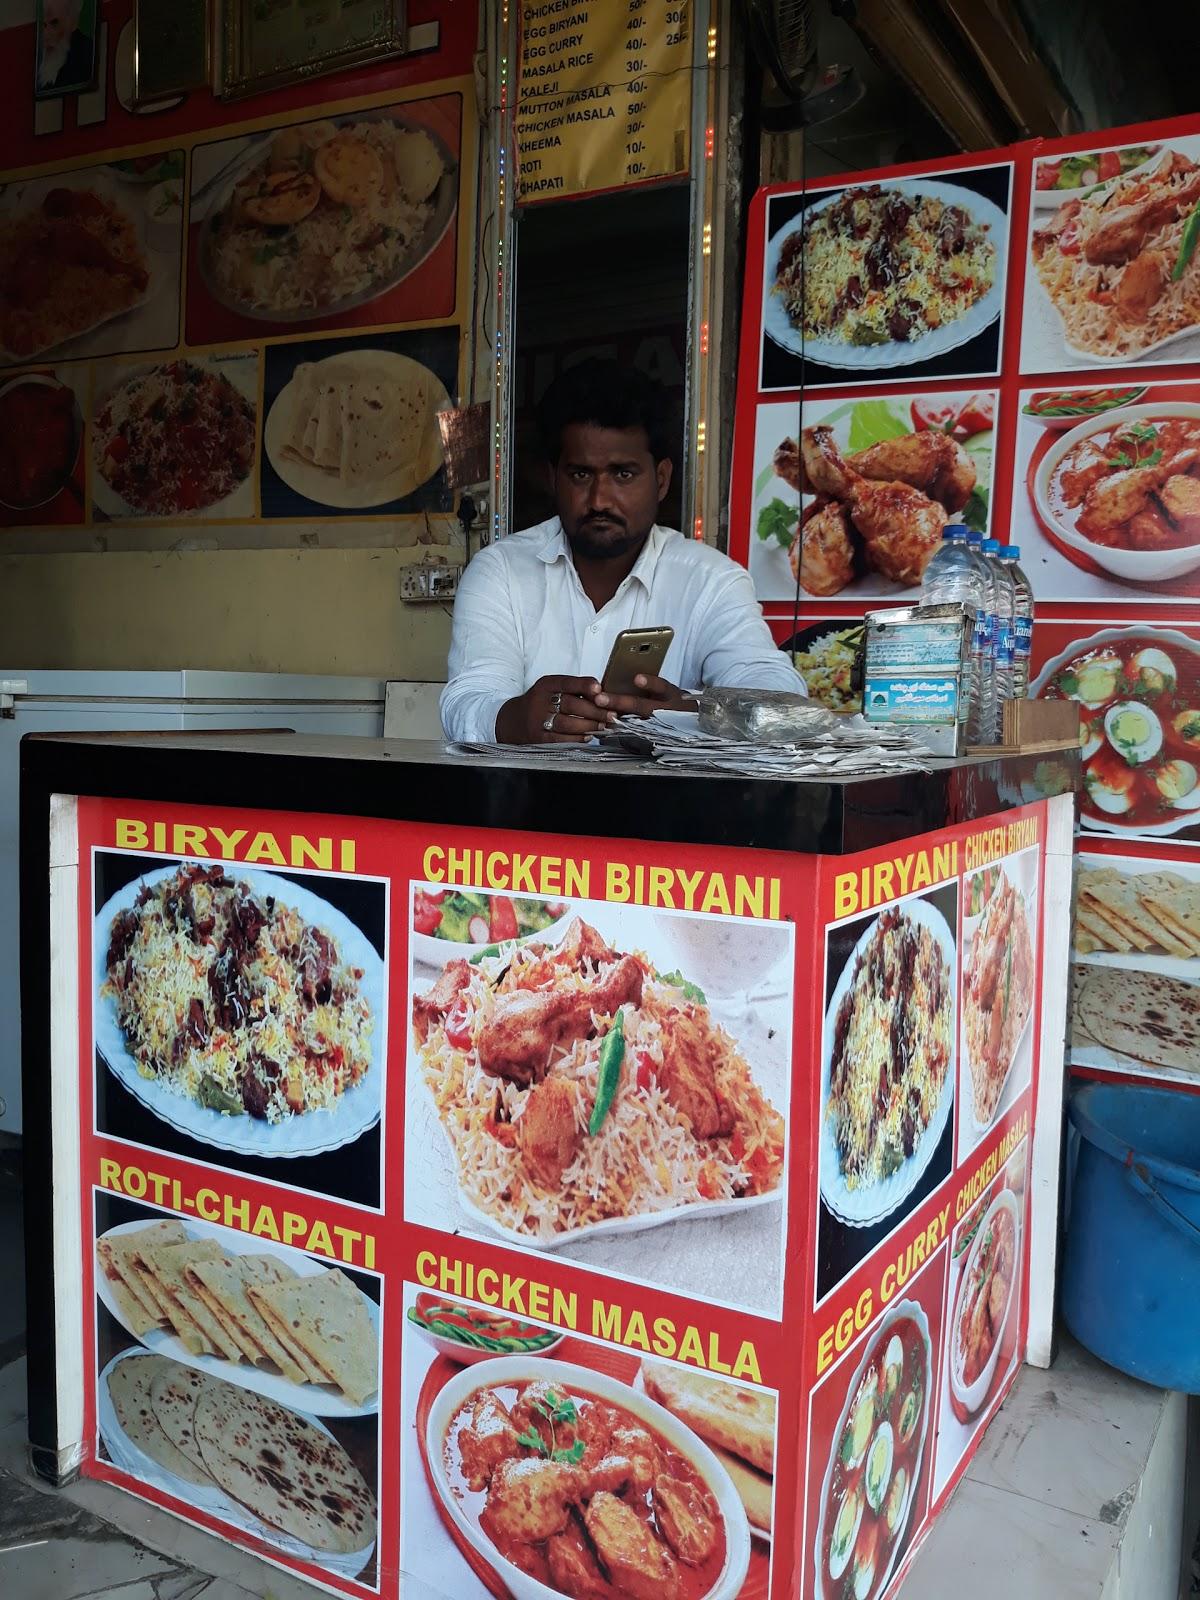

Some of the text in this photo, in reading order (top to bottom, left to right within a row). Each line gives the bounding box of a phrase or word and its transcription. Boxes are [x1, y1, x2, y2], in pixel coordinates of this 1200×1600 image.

[523, 27, 547, 40] EGG
[549, 12, 588, 34] BIRYANI
[524, 0, 569, 20] CHICKEN
[522, 60, 565, 78] MASALA
[568, 53, 594, 68] RICE
[626, 38, 647, 50] 40/-
[523, 46, 546, 60] EGG
[549, 34, 583, 54] CURRY
[627, 16, 646, 30] 40/-
[519, 81, 648, 115] MUTTON MASALA 40/-
[521, 60, 648, 97] KALEJI 30/-
[517, 102, 647, 134] CHICKEN MASALA 50/-
[519, 121, 645, 153] KHEEMA 30/-
[520, 141, 646, 174] ROTI 10/-
[520, 162, 646, 195] CHAPATI 10/-
[115, 818, 356, 872] BIRYANI
[965, 815, 1038, 870] CHICKEN BIRYANI
[423, 845, 782, 920] CHICKEN BIRYANI
[834, 841, 958, 919] BIRYANI
[956, 1110, 1028, 1220] CHICKEN MASALA
[99, 1157, 376, 1269] ROTI-CHAPATI
[816, 1202, 950, 1377] EGG CURRY
[415, 1251, 763, 1383] CHICKEN MASALA
